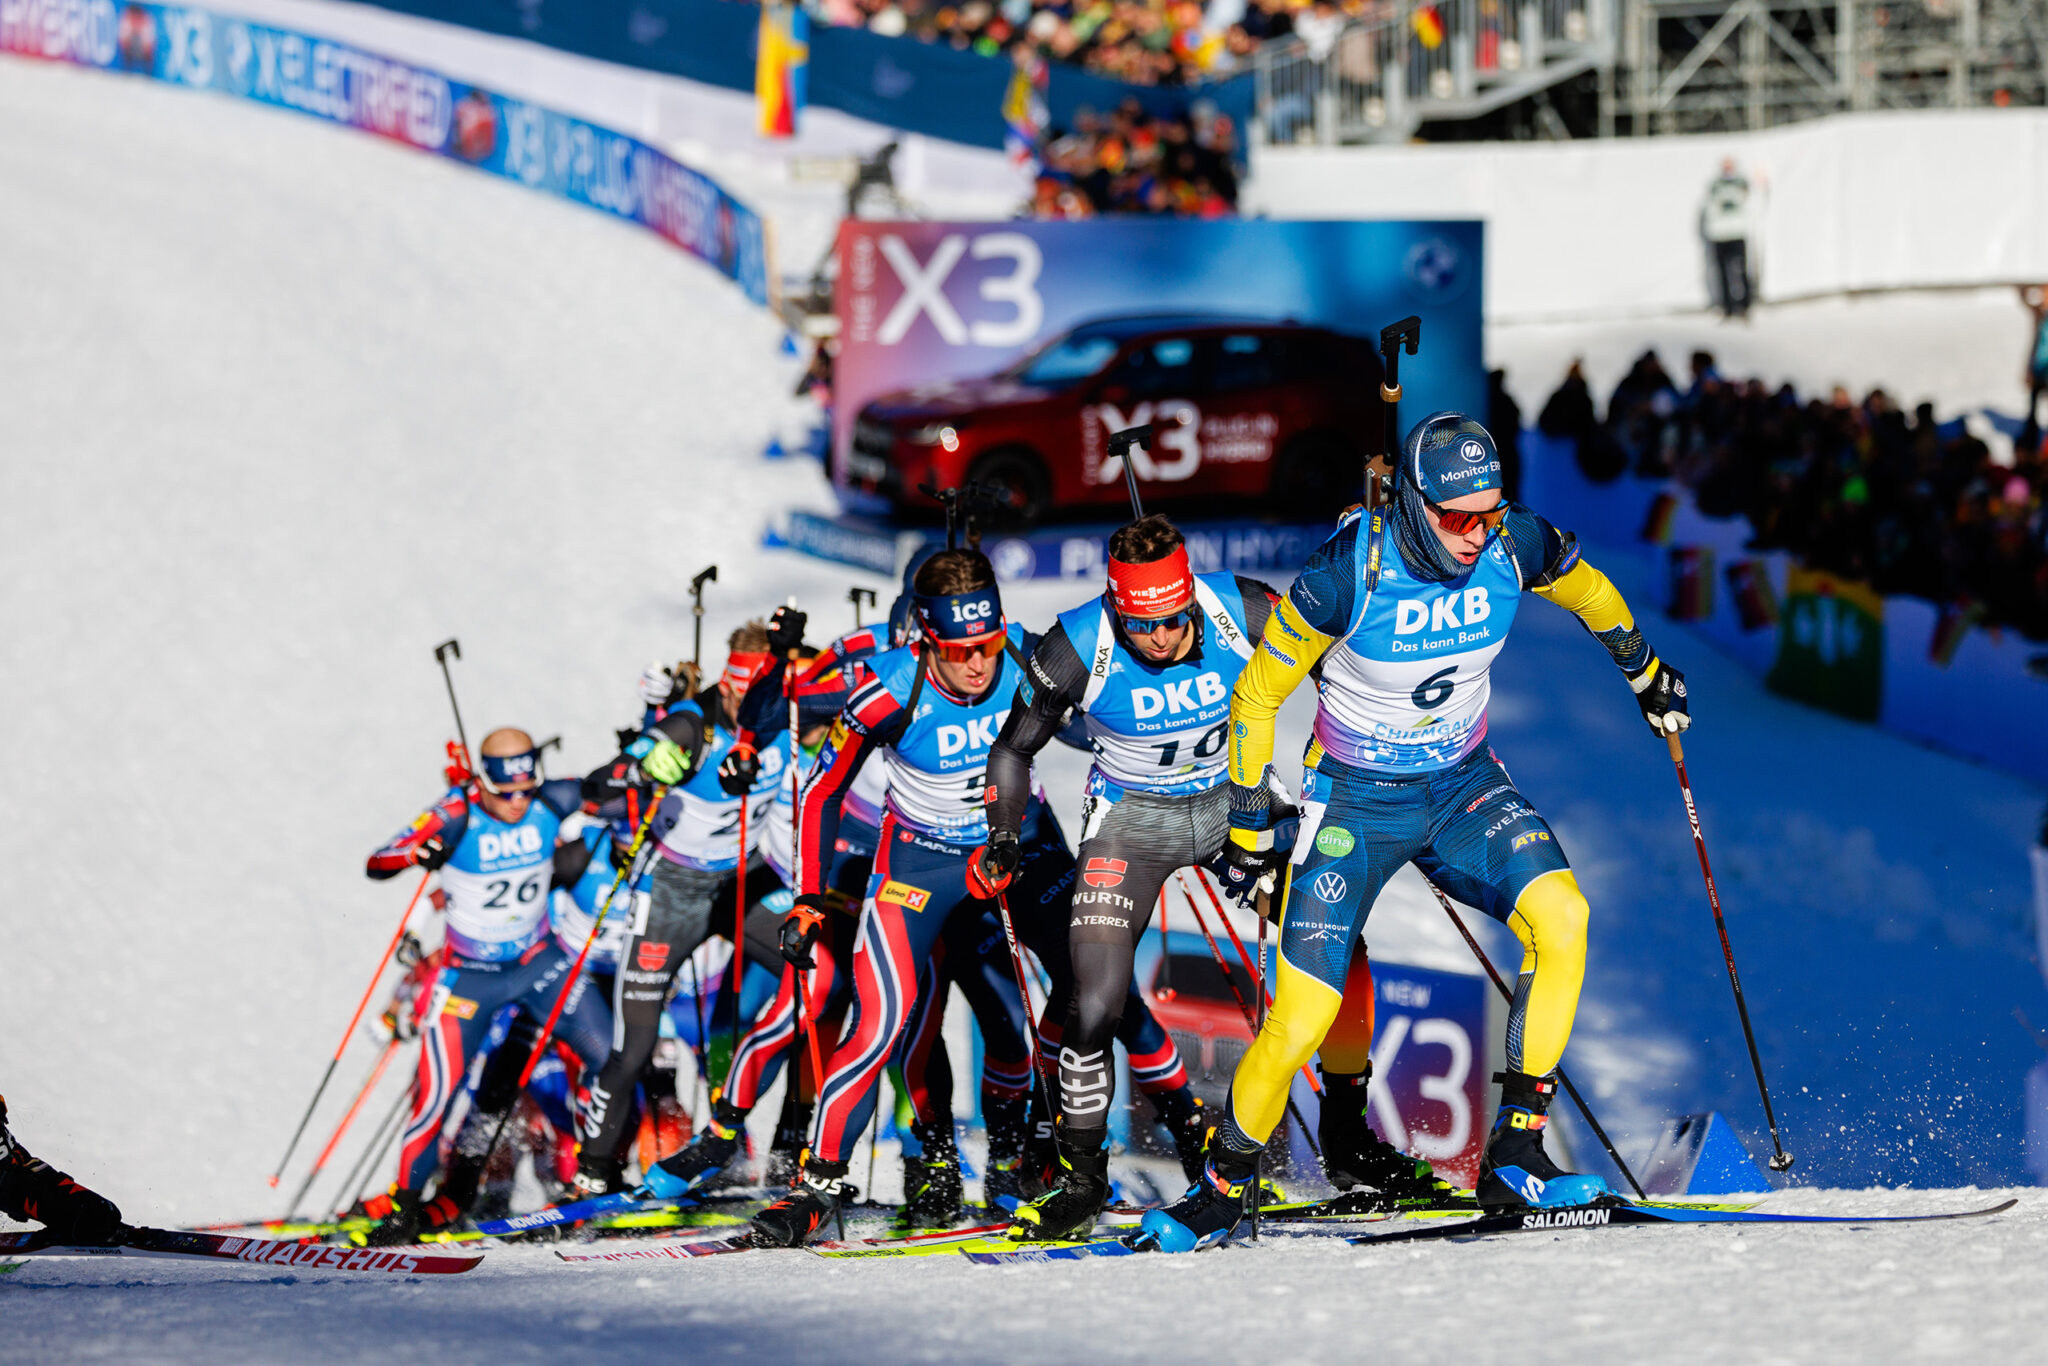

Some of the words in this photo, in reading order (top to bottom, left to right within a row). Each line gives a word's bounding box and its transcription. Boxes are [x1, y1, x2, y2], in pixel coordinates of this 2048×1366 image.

[876, 232, 1044, 347] X3
[1097, 398, 1201, 484] X3
[1440, 464, 1489, 484] Monitor
[1373, 515, 1382, 534] ATG
[951, 600, 993, 623] ice
[1394, 586, 1491, 635] DKB
[1213, 611, 1239, 642] JOKA
[1392, 640, 1418, 652] Das
[1422, 637, 1454, 650] kann
[1458, 627, 1490, 644] Bank
[1029, 653, 1058, 690] TERREX
[1093, 646, 1110, 679] JOKA
[1131, 671, 1227, 719] DKB
[1411, 665, 1459, 710] 6
[1136, 721, 1162, 732] Das
[1164, 715, 1196, 729] kann
[1199, 703, 1229, 721] Bank
[1375, 714, 1473, 740] CHIEMGAU
[939, 759, 964, 769] Das
[1682, 787, 1703, 841] SWIX
[478, 825, 543, 862] DKB
[1319, 832, 1351, 849] dina
[1515, 831, 1550, 850] ATG
[483, 872, 541, 910] 26
[1071, 891, 1134, 911] WÜRTH
[1002, 909, 1019, 958] SWIX
[1082, 915, 1130, 929] TERREX
[1291, 921, 1350, 933] SWEDEMOUNT
[1259, 937, 1267, 981] SWIX
[1381, 978, 1432, 1009] NEW
[1059, 1046, 1109, 1116] GER
[505, 1207, 566, 1230] SALOMON
[1522, 1208, 1610, 1229] SALOMON
[237, 1239, 425, 1274] MADSHUS
